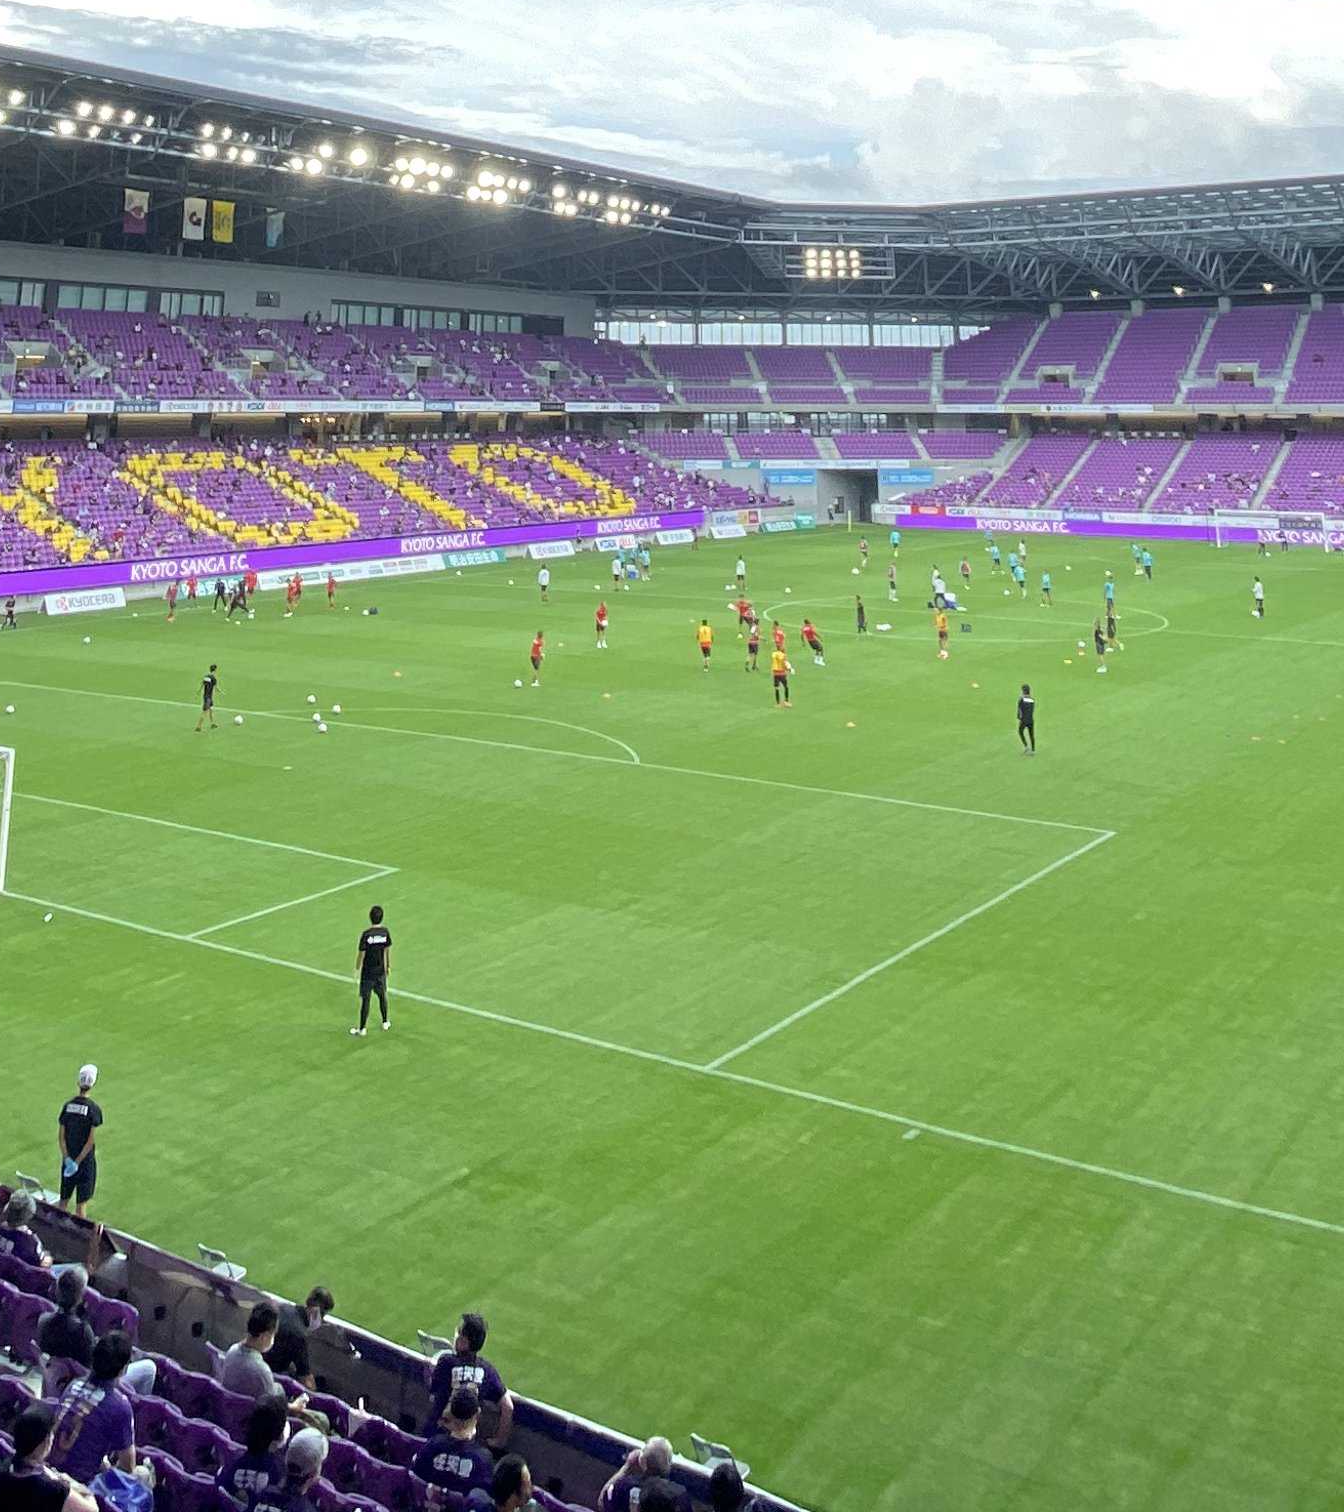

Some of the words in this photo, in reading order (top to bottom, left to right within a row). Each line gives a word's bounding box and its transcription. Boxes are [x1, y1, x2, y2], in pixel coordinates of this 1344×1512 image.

[976, 518, 1011, 530] KYOTO
[1014, 519, 1051, 532] SANGA
[400, 536, 435, 554] KYOTO
[435, 533, 469, 550] SANGA
[130, 560, 178, 581] KYOTO
[179, 555, 226, 576] SANGA
[229, 553, 250, 570] F.C.
[69, 593, 116, 608] KYOCERA
